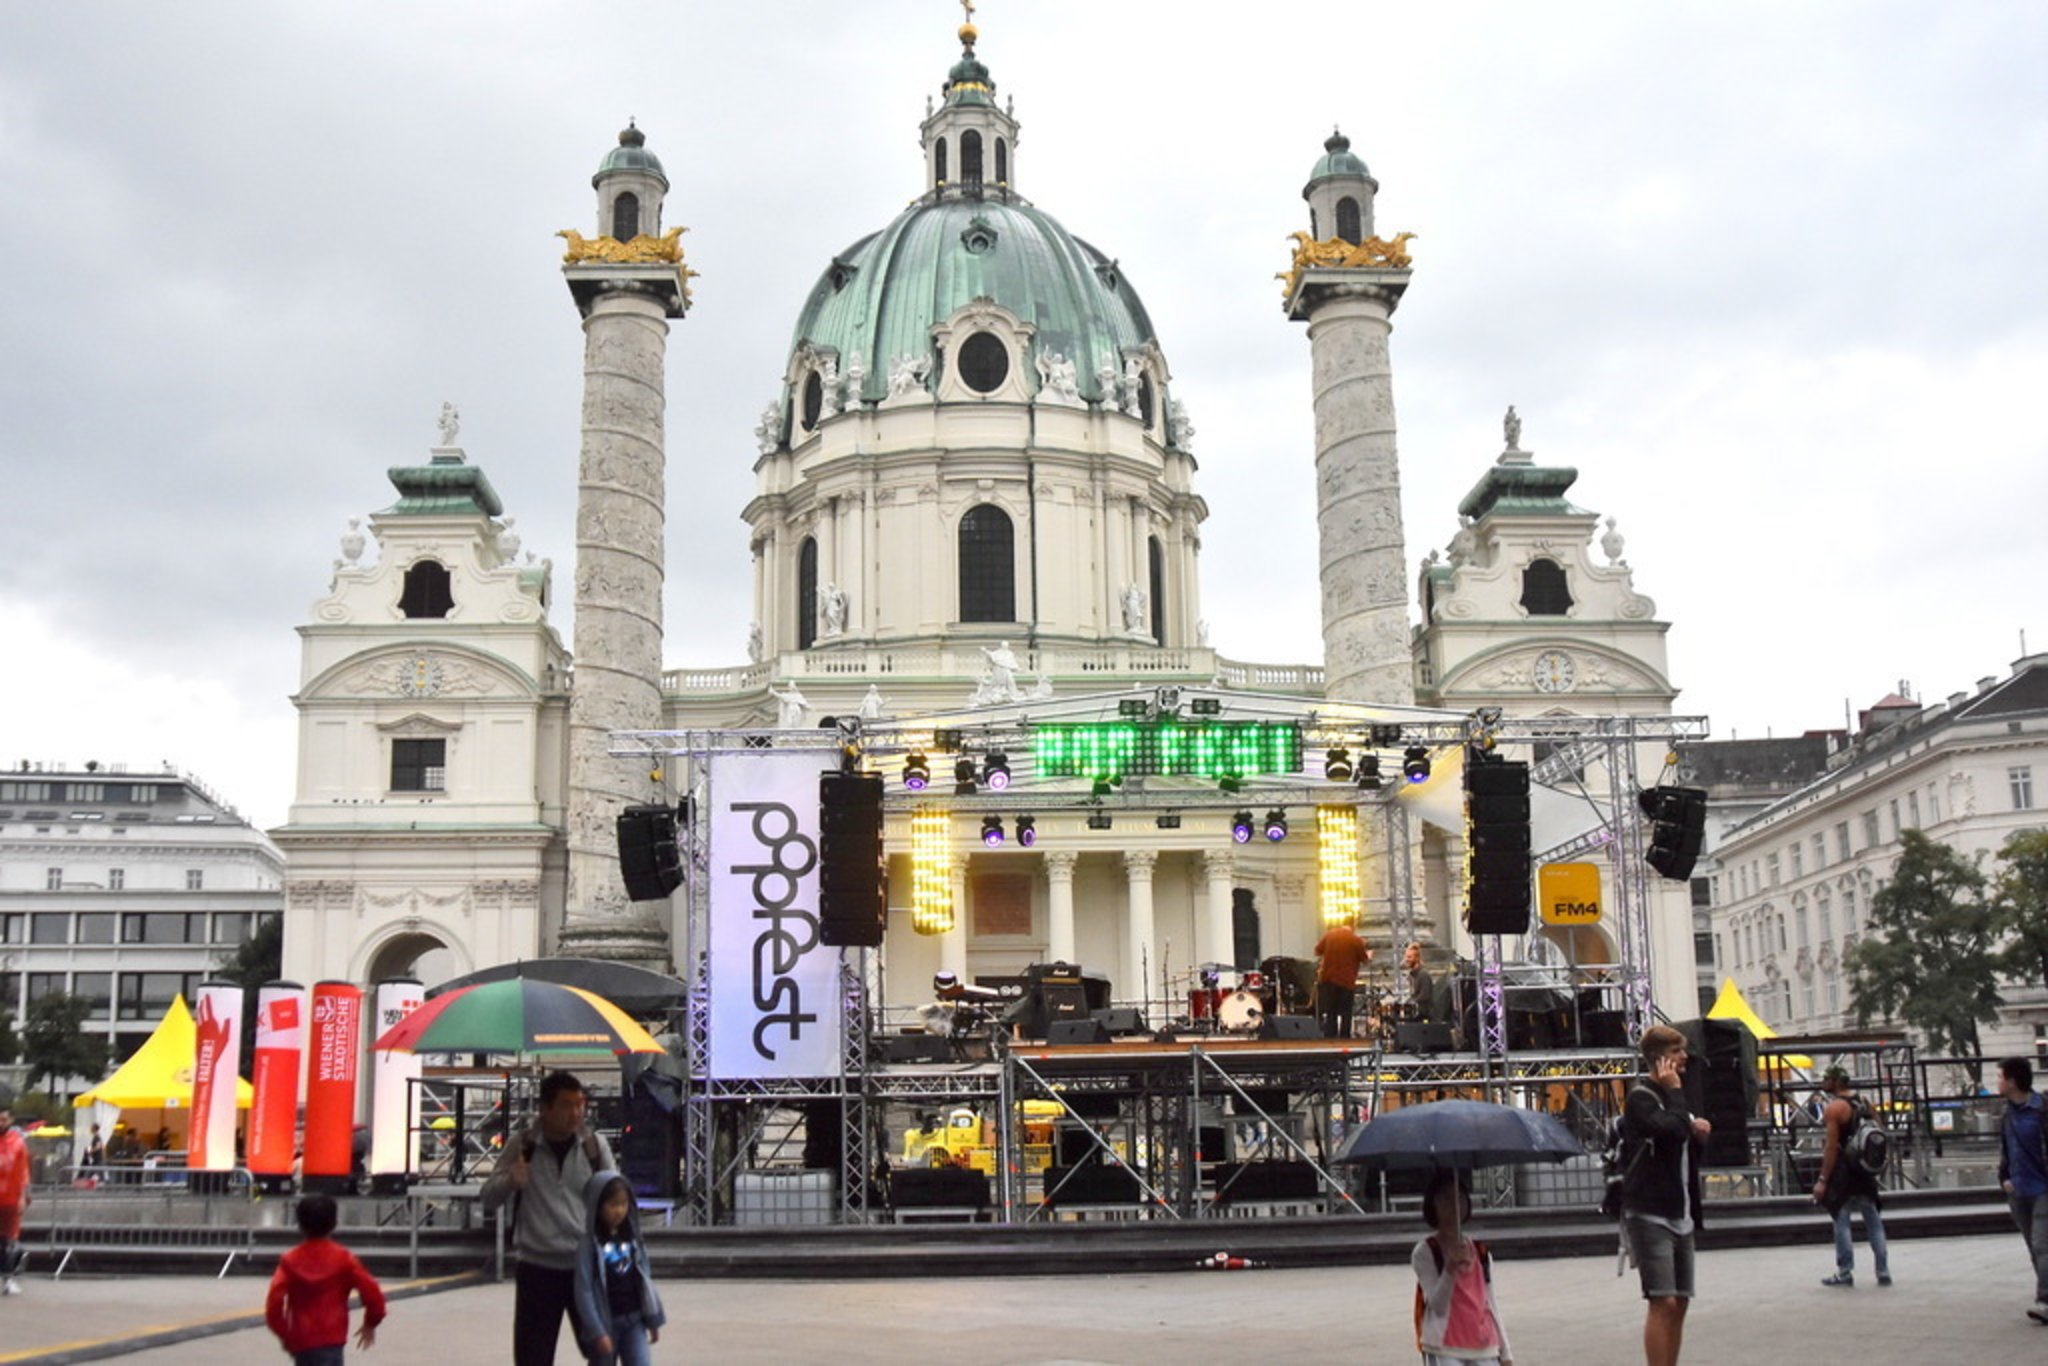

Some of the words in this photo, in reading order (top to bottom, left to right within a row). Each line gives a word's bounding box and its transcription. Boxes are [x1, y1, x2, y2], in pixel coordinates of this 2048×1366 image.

[731, 803, 820, 1060] popfest
[1554, 902, 1598, 916] FM4
[320, 1023, 335, 1080] WIENER
